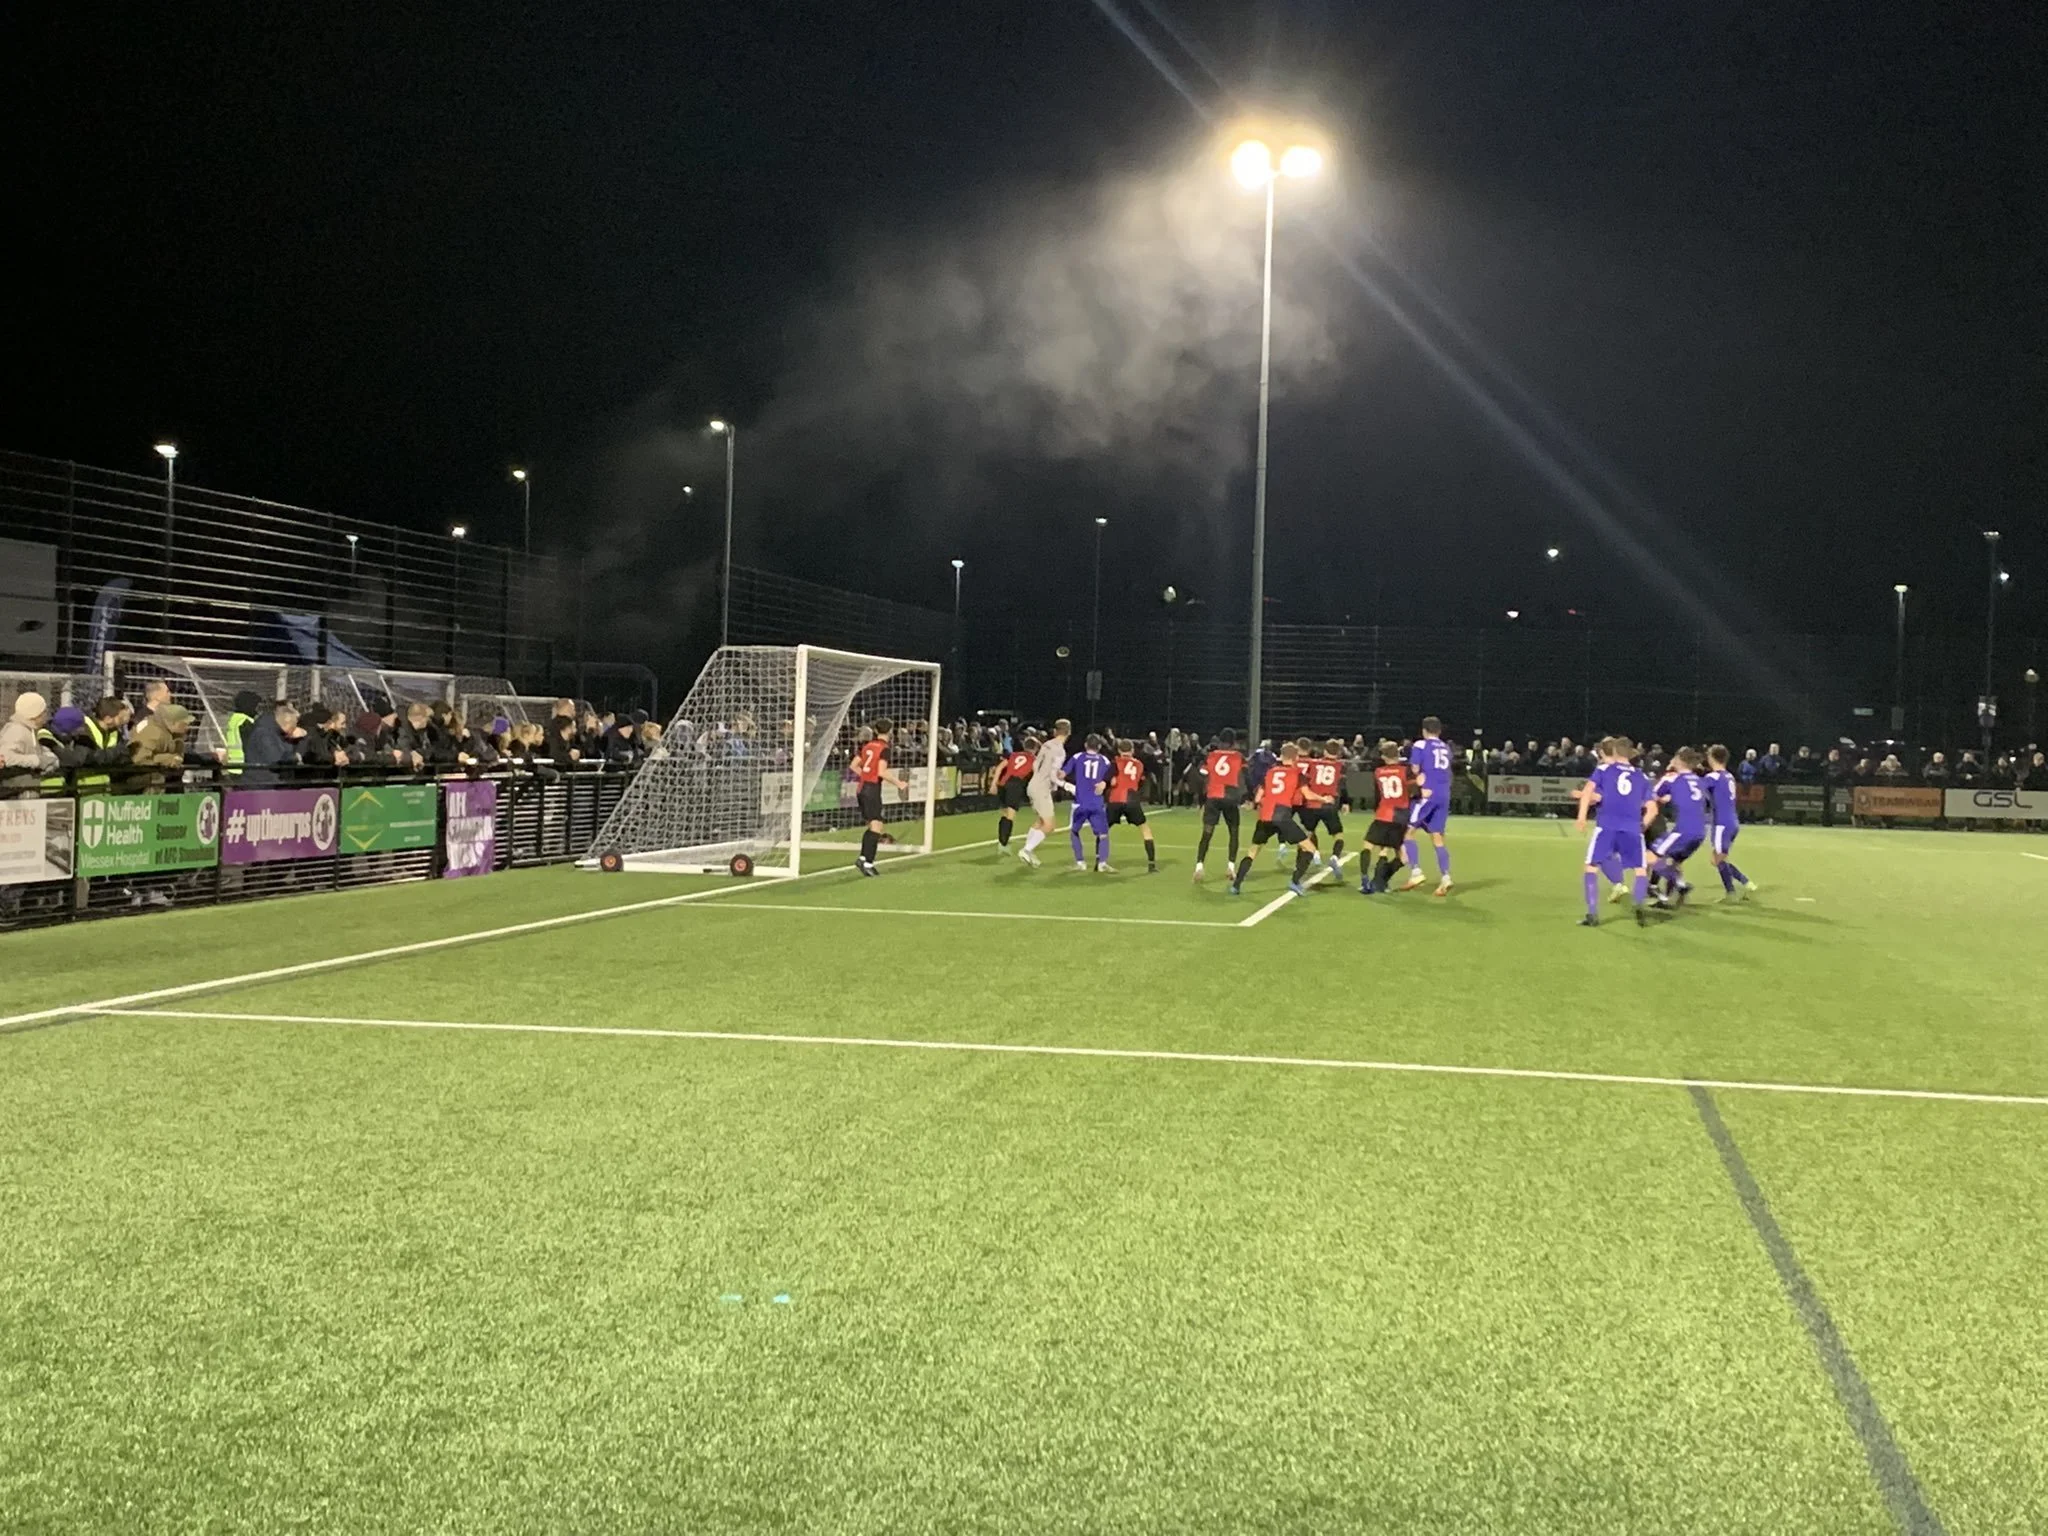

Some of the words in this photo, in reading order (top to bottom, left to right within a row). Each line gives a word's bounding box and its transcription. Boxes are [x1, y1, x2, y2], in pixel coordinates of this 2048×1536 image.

[862, 749, 873, 773] 2
[1013, 755, 1028, 770] 9
[1083, 759, 1099, 779] 11
[1214, 755, 1231, 776] 6
[1434, 748, 1449, 770] 15
[1123, 761, 1137, 781] 4
[1315, 764, 1336, 785] 18
[1271, 772, 1287, 794] 5
[1379, 775, 1403, 799] 10
[1617, 771, 1632, 795] 6
[1688, 780, 1702, 801] 5
[1973, 790, 2033, 809] GSL
[107, 799, 152, 822] Nuffield
[106, 824, 144, 846] Health
